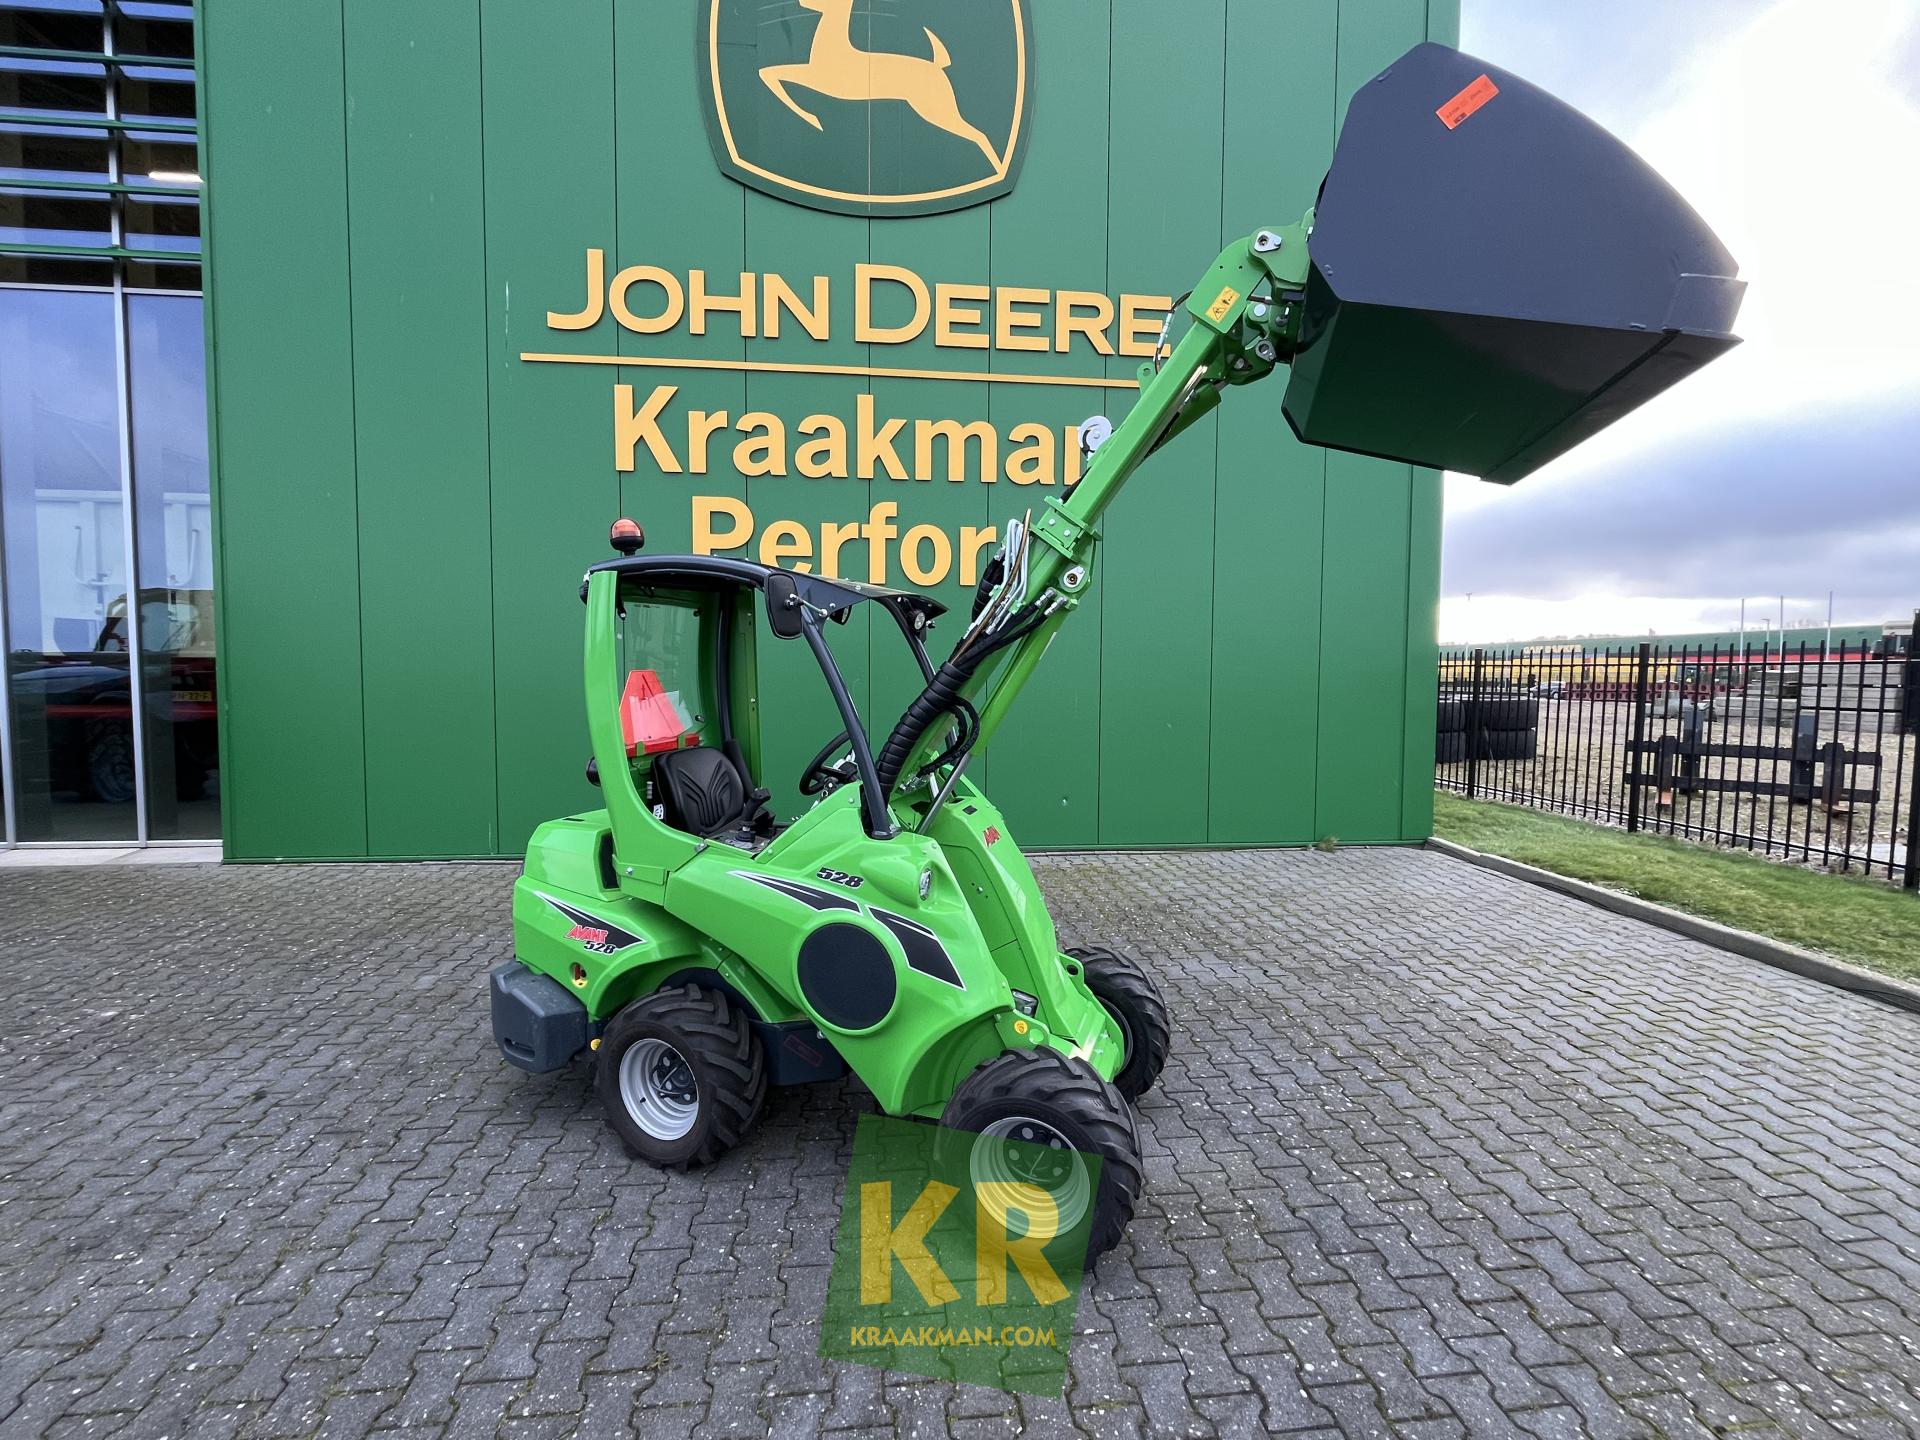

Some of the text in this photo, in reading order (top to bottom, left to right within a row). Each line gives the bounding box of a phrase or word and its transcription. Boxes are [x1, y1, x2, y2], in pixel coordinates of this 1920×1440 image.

[547, 248, 1172, 357] JOHN DEERE
[816, 866, 864, 888] 528
[565, 924, 609, 944] AVANT
[583, 940, 617, 955] 528
